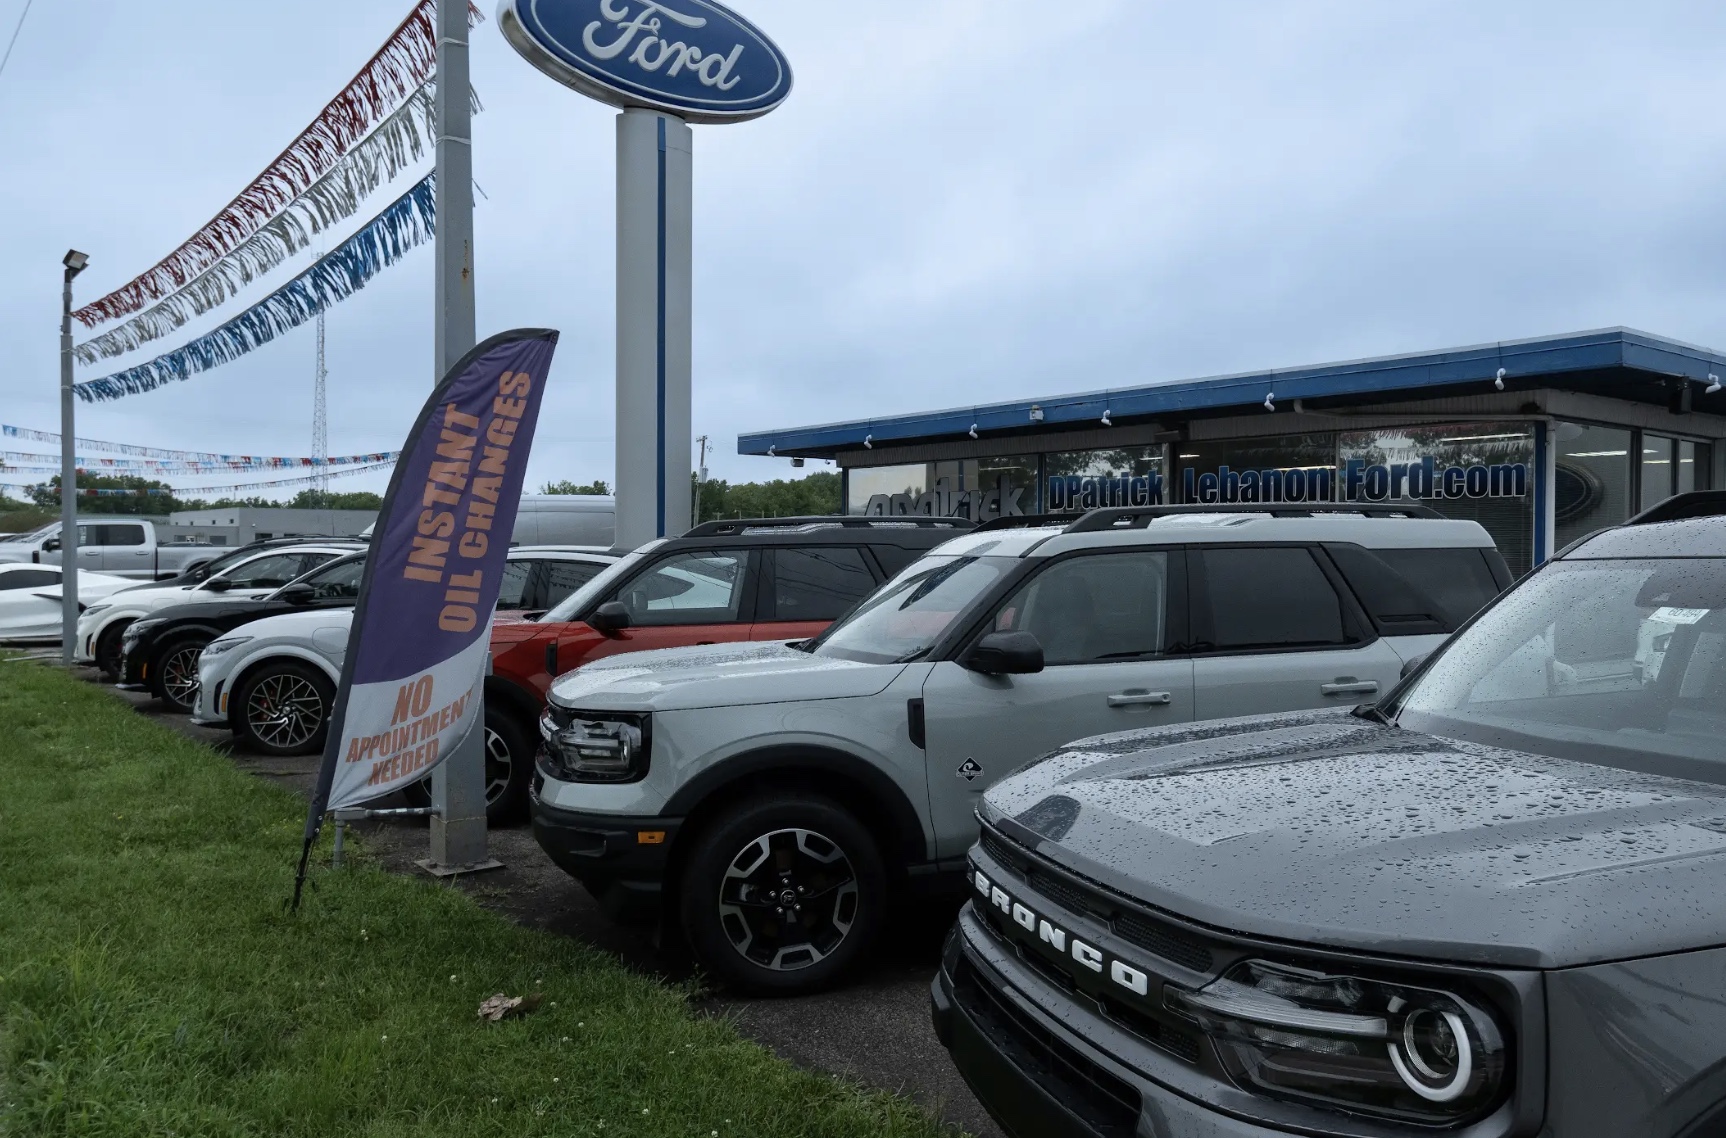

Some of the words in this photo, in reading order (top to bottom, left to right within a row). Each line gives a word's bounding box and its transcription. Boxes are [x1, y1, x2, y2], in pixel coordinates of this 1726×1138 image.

[582, 0, 745, 91] Ford
[403, 403, 480, 583] INSTANT
[458, 370, 531, 559] CHANGES
[1048, 469, 1163, 511] DPatrick
[1183, 465, 1331, 504] Lebanon
[1345, 455, 1526, 502] Ford.com
[438, 568, 483, 634] OIL
[345, 686, 473, 763] APPOINTMENT
[390, 674, 434, 727] NO
[367, 738, 440, 787] NEEDED
[974, 870, 1148, 996] BRONCO
